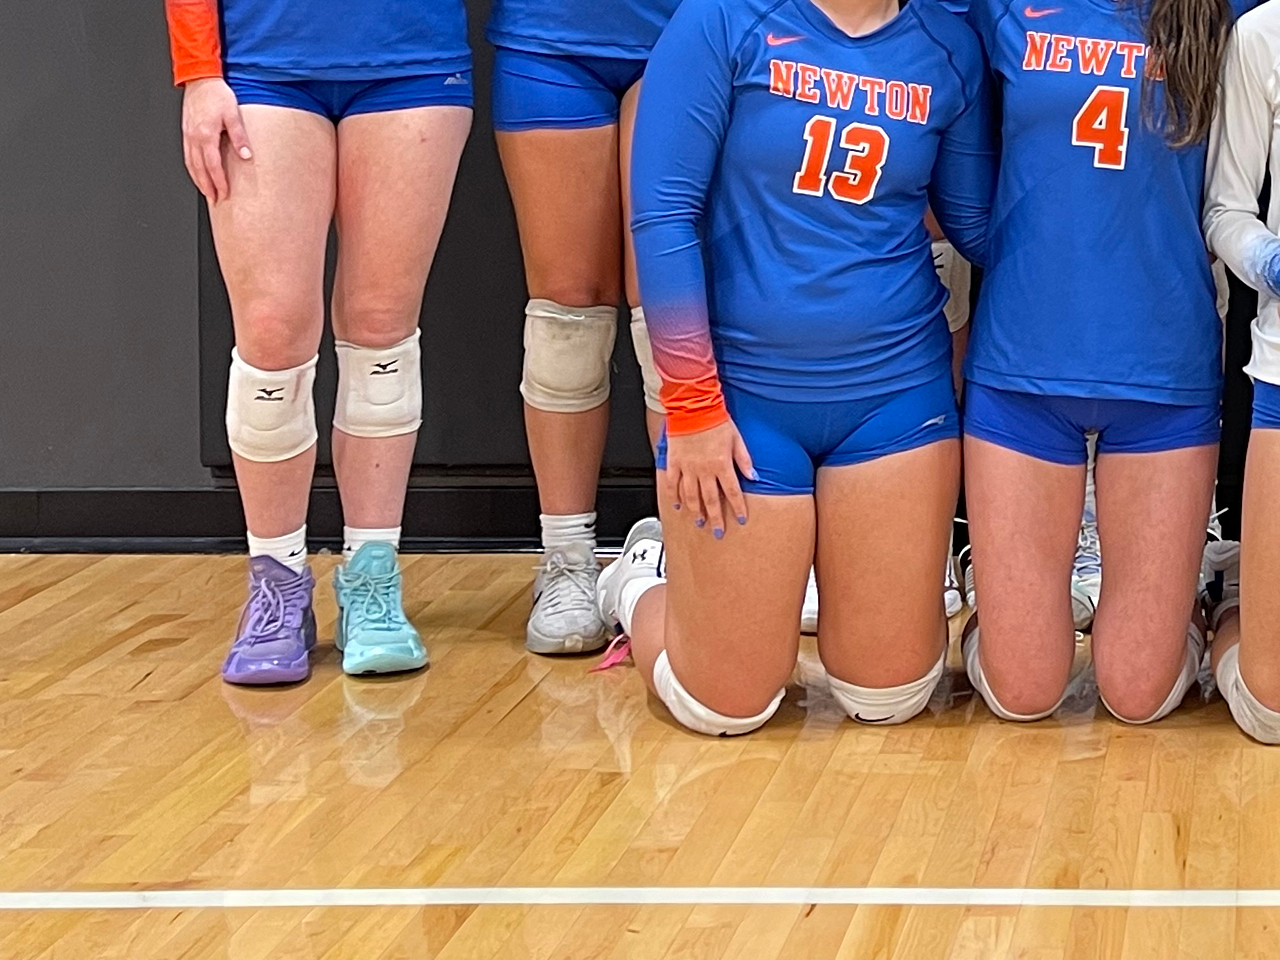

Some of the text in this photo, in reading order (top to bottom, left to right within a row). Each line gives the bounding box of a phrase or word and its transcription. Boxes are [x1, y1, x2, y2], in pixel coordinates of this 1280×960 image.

[769, 59, 932, 125] NEWTON
[1022, 31, 1168, 81] NEWT
[793, 114, 890, 205] 13
[1072, 84, 1130, 171] 4
